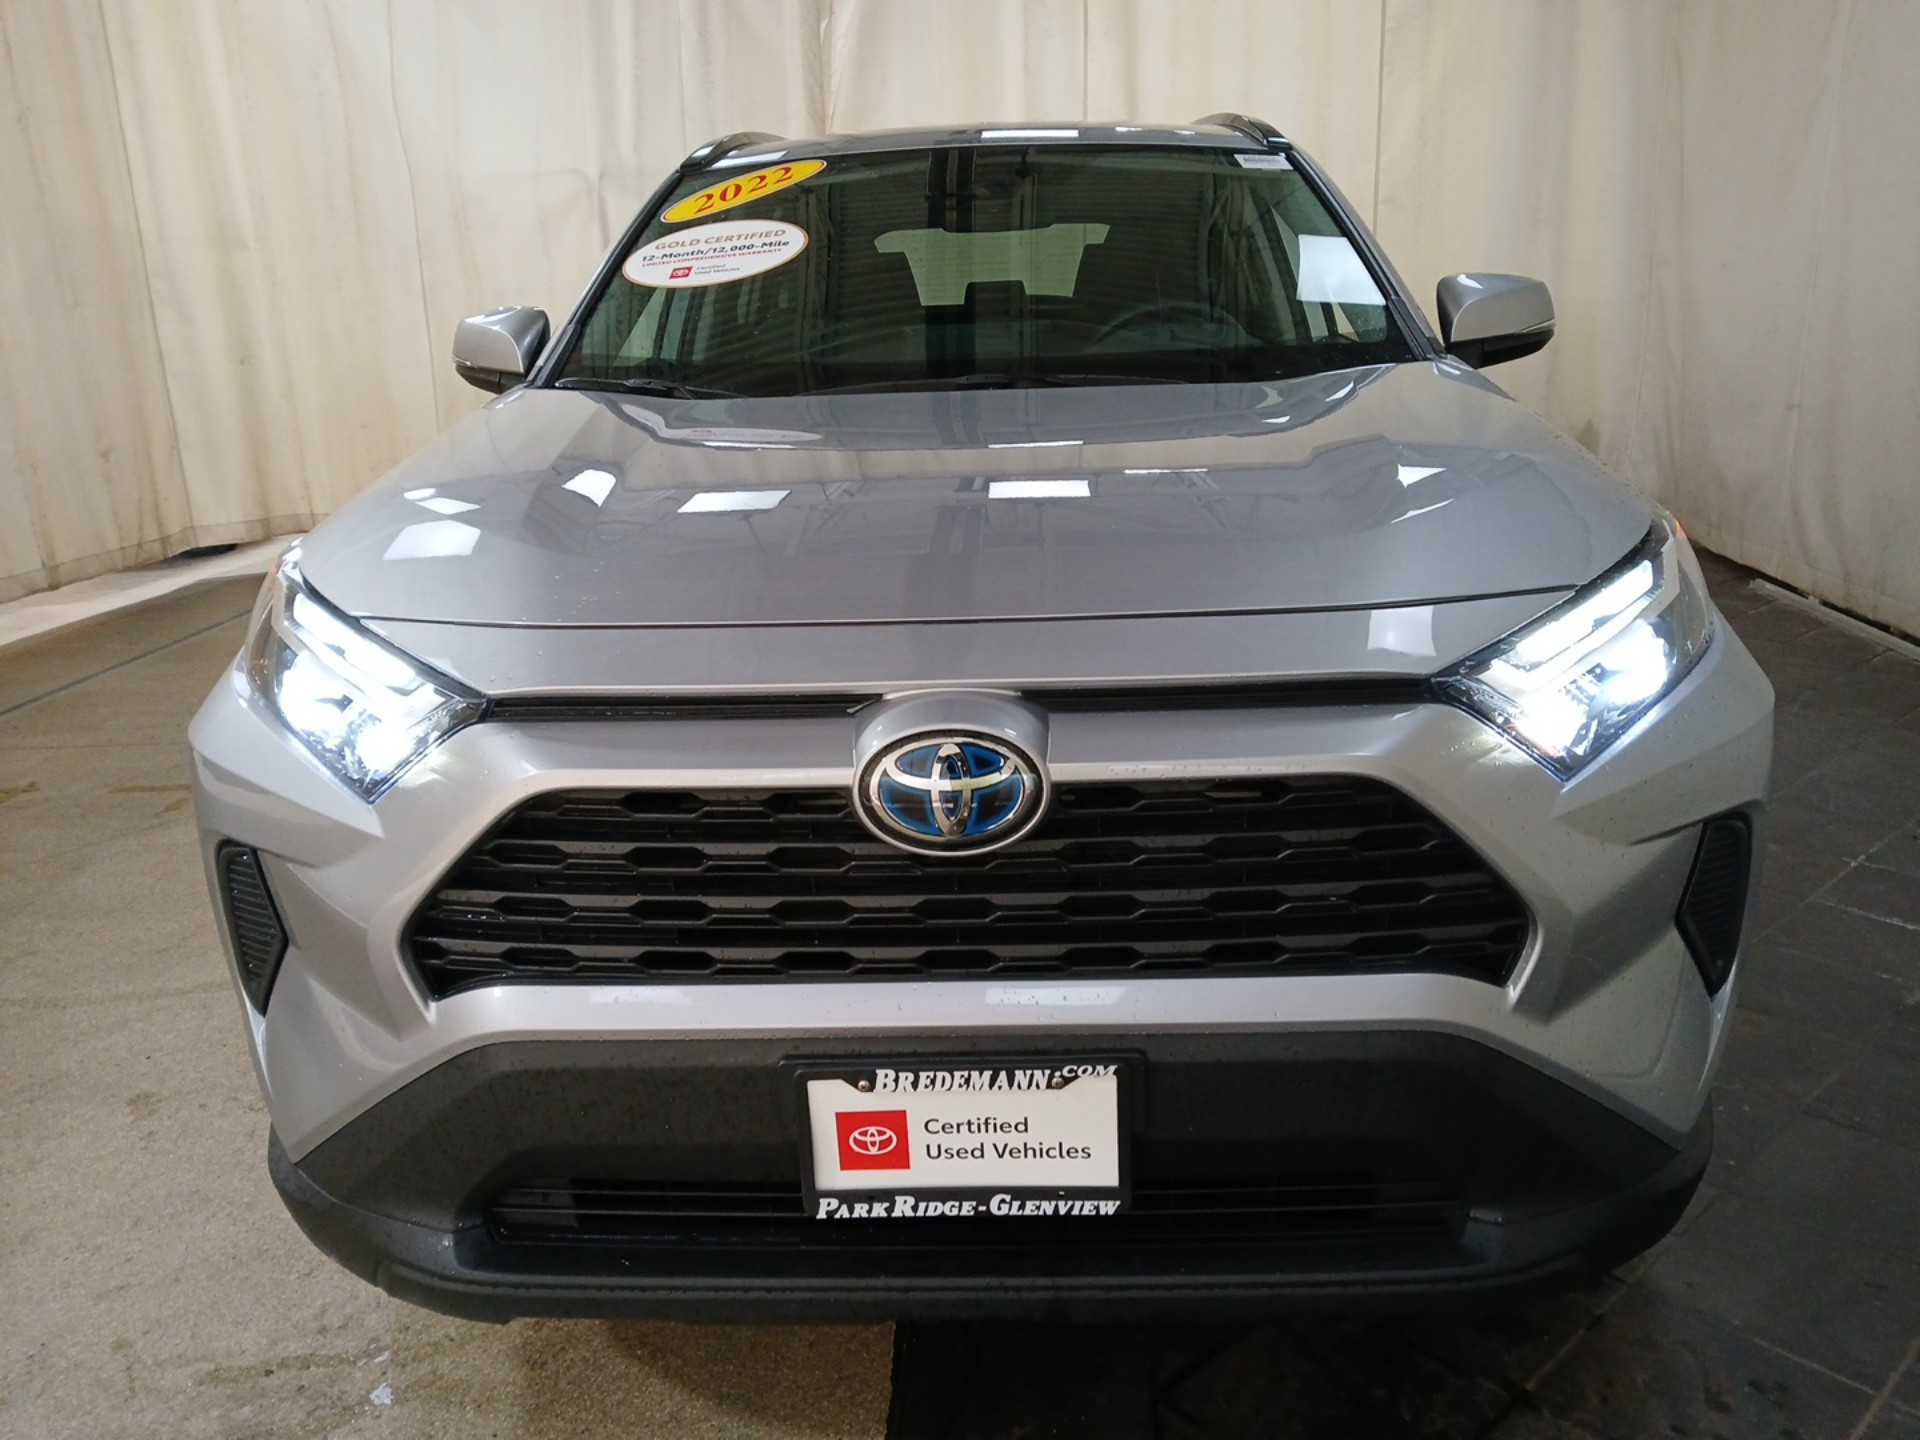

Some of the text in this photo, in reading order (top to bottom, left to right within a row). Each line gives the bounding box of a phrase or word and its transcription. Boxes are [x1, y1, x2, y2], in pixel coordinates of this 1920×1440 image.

[693, 165, 794, 215] 2022
[655, 229, 787, 250] GOLD CERTIFIED
[923, 1117, 1029, 1135] Certified
[925, 1141, 1092, 1160] Used Vehicles
[816, 1197, 890, 1220] PARK
